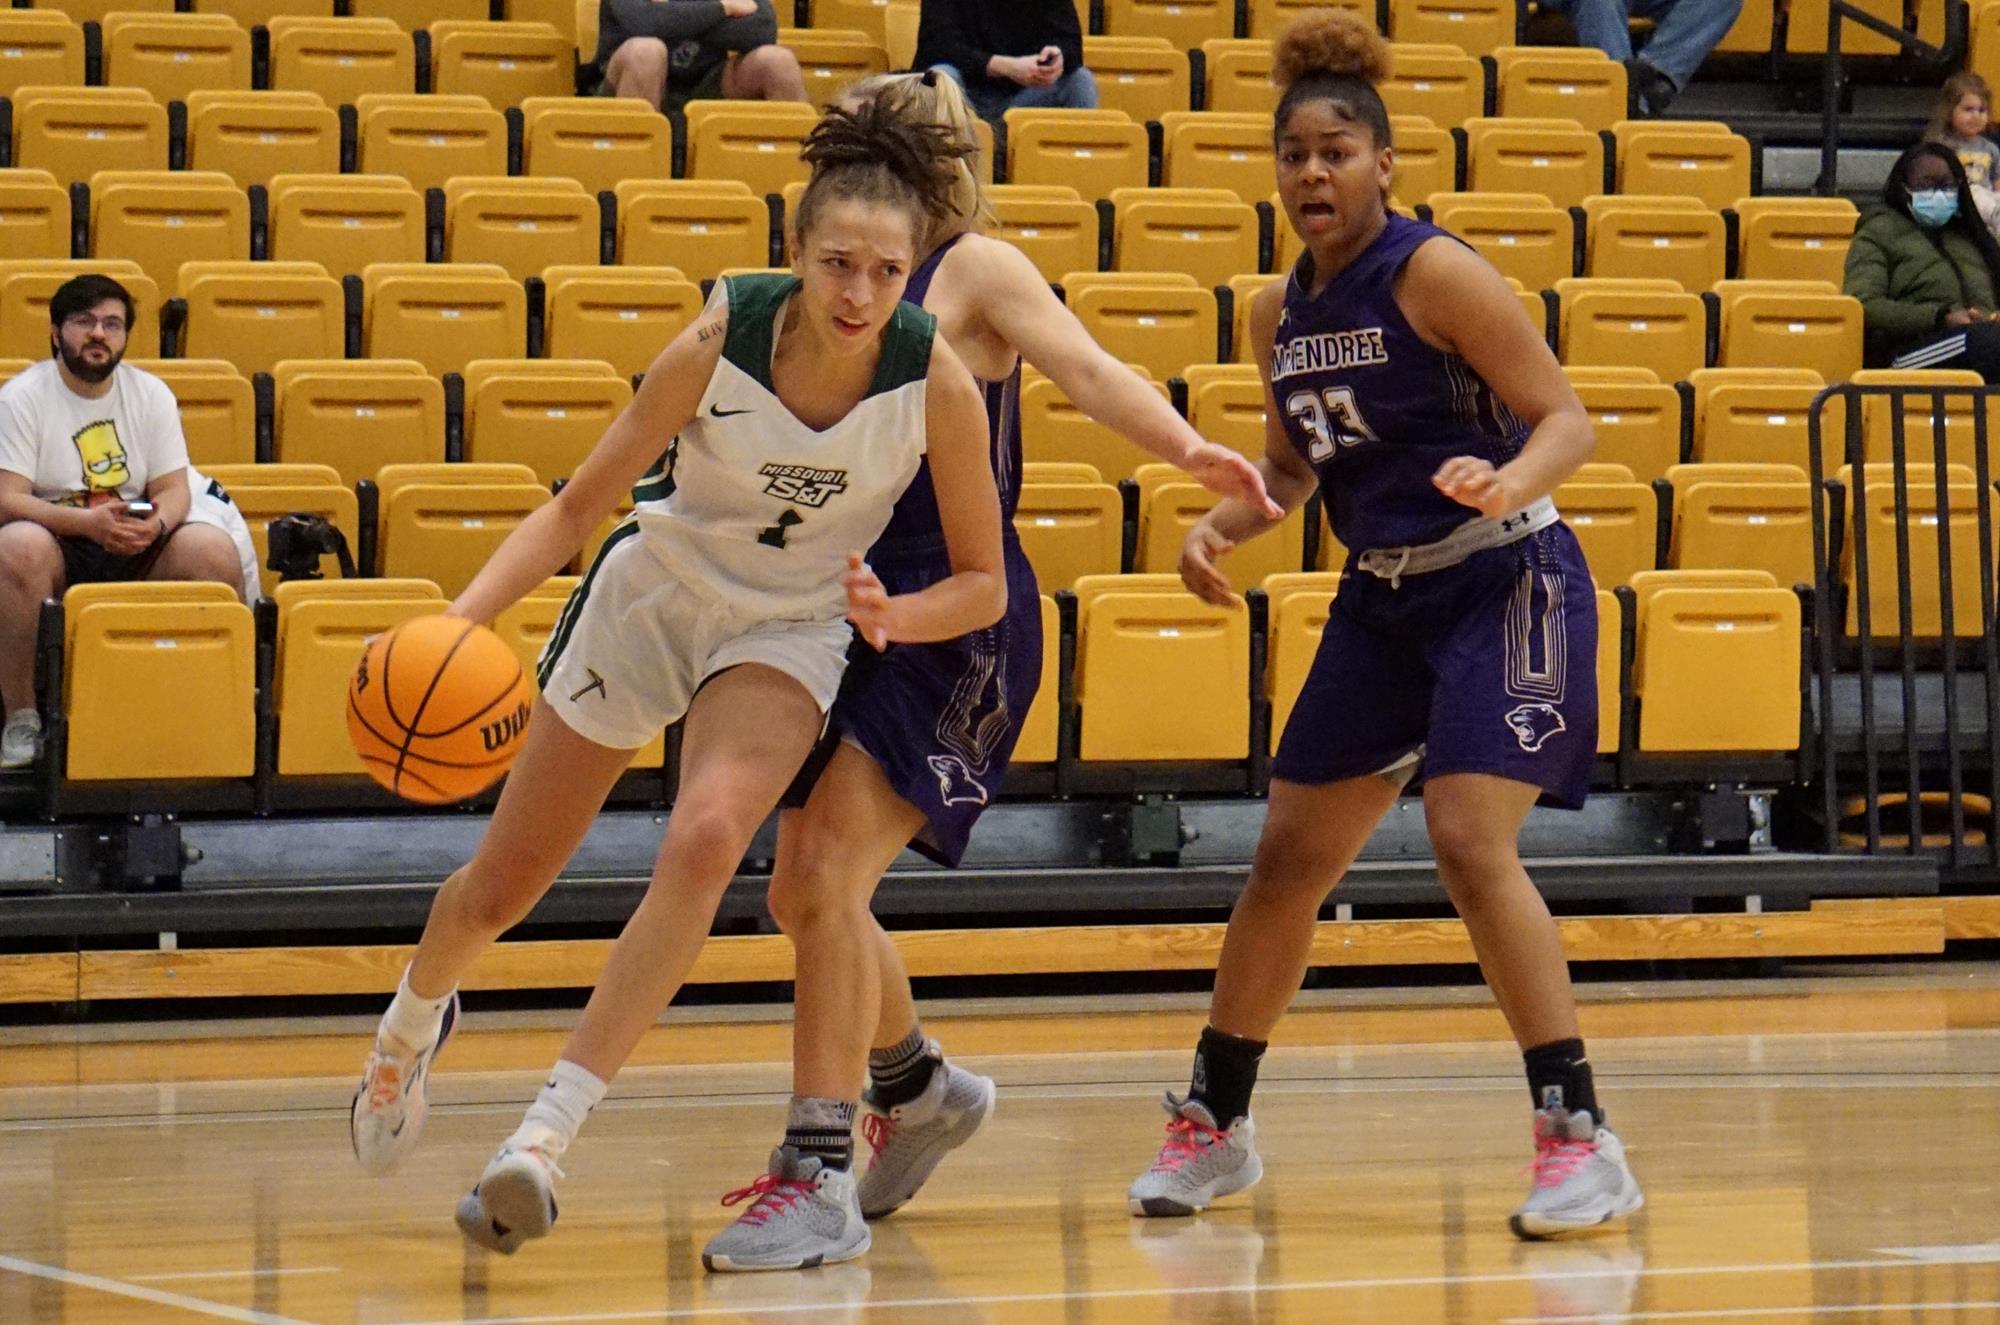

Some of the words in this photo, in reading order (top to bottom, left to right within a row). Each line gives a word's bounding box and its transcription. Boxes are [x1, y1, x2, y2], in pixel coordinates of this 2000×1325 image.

[1286, 385, 1381, 464] 33
[760, 463, 845, 484] MISSOURI
[764, 476, 846, 508] S&T
[757, 508, 804, 550] 1
